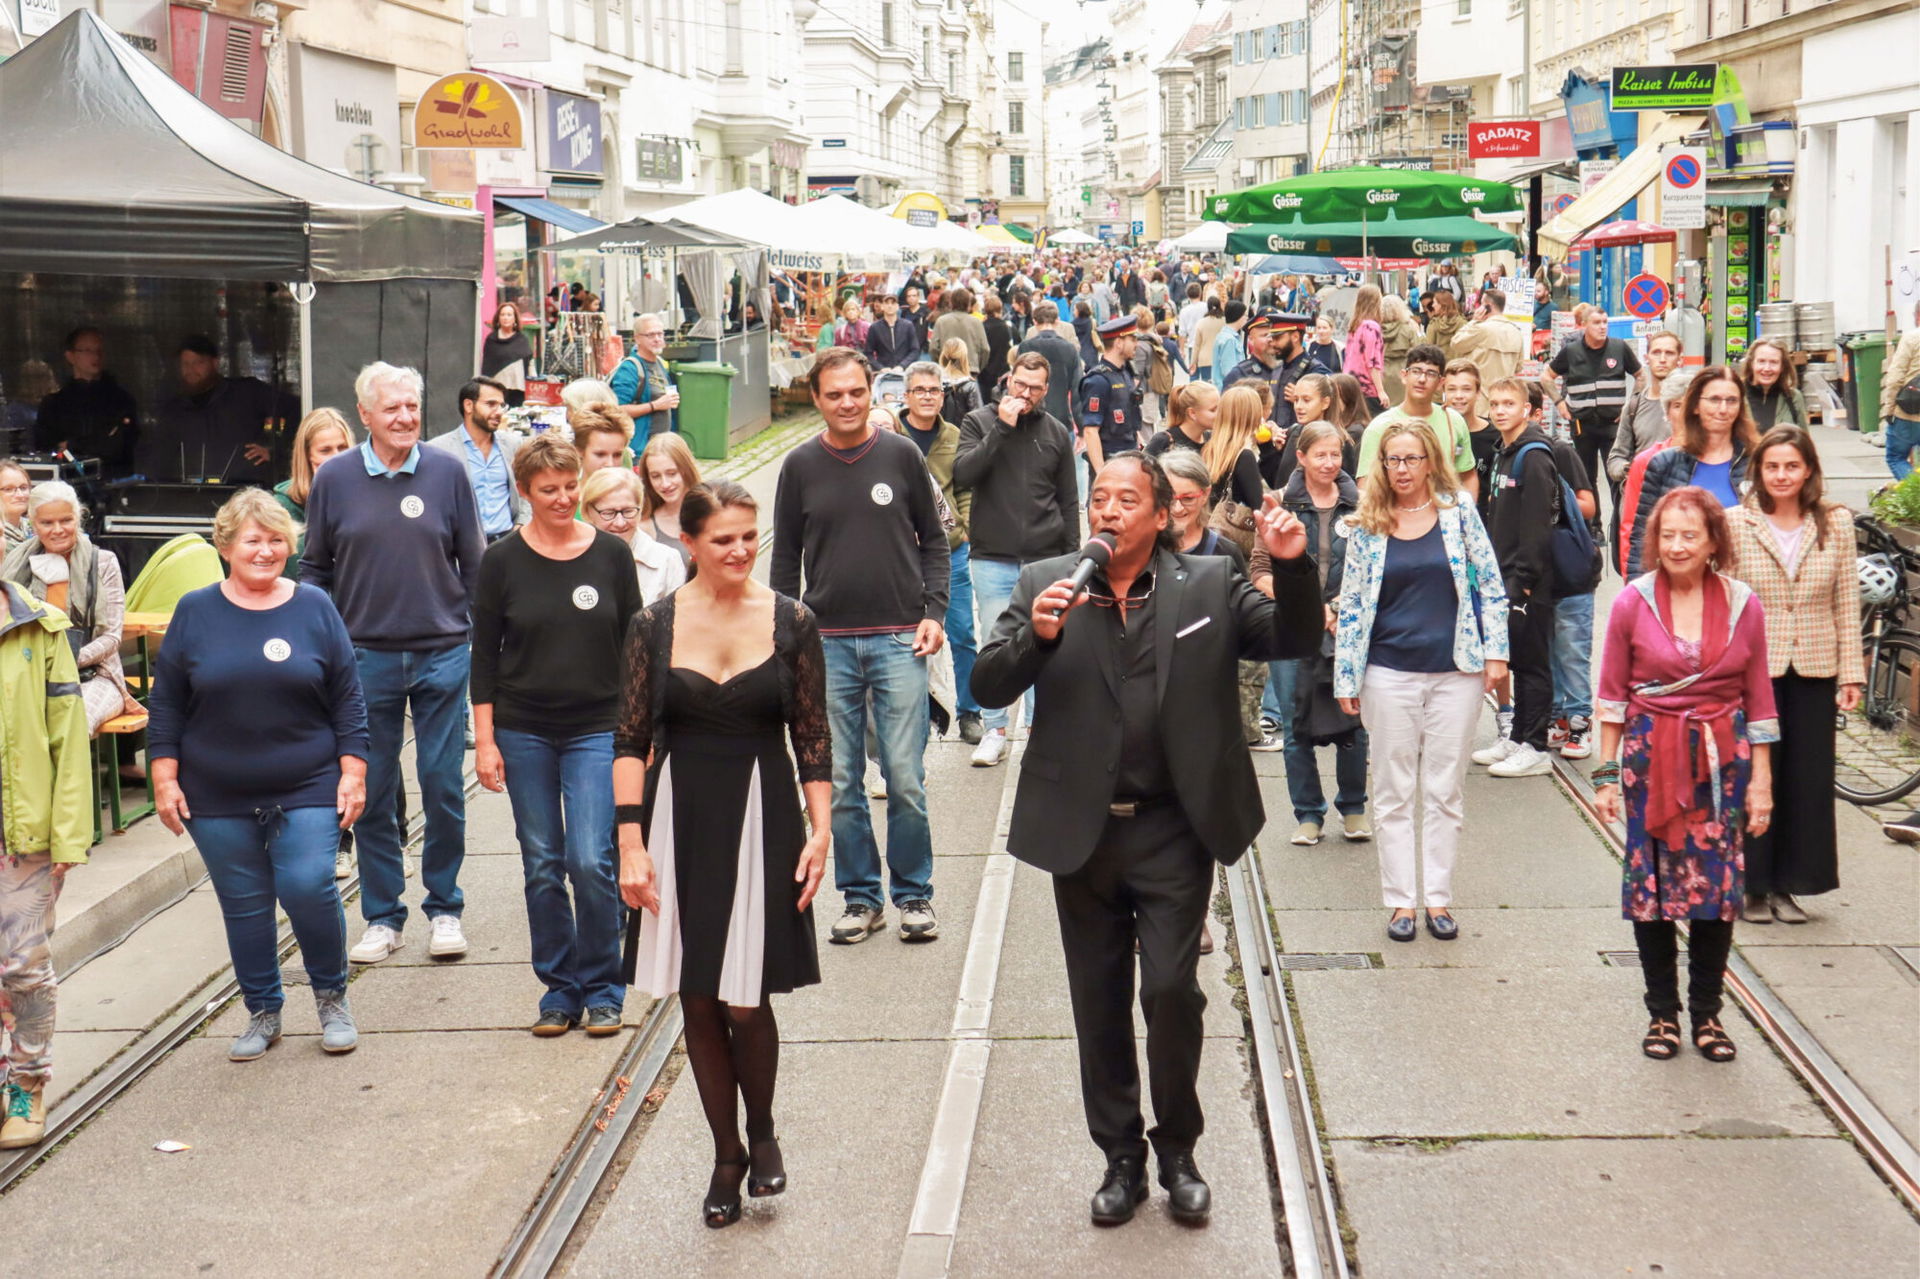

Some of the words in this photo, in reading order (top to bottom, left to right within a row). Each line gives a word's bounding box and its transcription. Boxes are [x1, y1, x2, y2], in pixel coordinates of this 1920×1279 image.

[1619, 71, 1662, 91] Kaiser
[1668, 71, 1712, 90] Imbiss
[334, 98, 373, 126] knockbox
[423, 121, 513, 146] Gradwohl
[1476, 127, 1532, 145] RADATZ
[1273, 193, 1303, 210] Gösser
[1366, 189, 1400, 204] Gösser
[1460, 187, 1486, 203] Gösser
[1663, 194, 1703, 202] Kurzparkzone
[1267, 234, 1306, 252] Gösser
[1412, 237, 1452, 256] Gösser
[767, 249, 822, 269] delweiss
[1499, 279, 1525, 293] FRISCH
[1635, 325, 1661, 335] Anfang
[529, 383, 548, 392] CAMP
